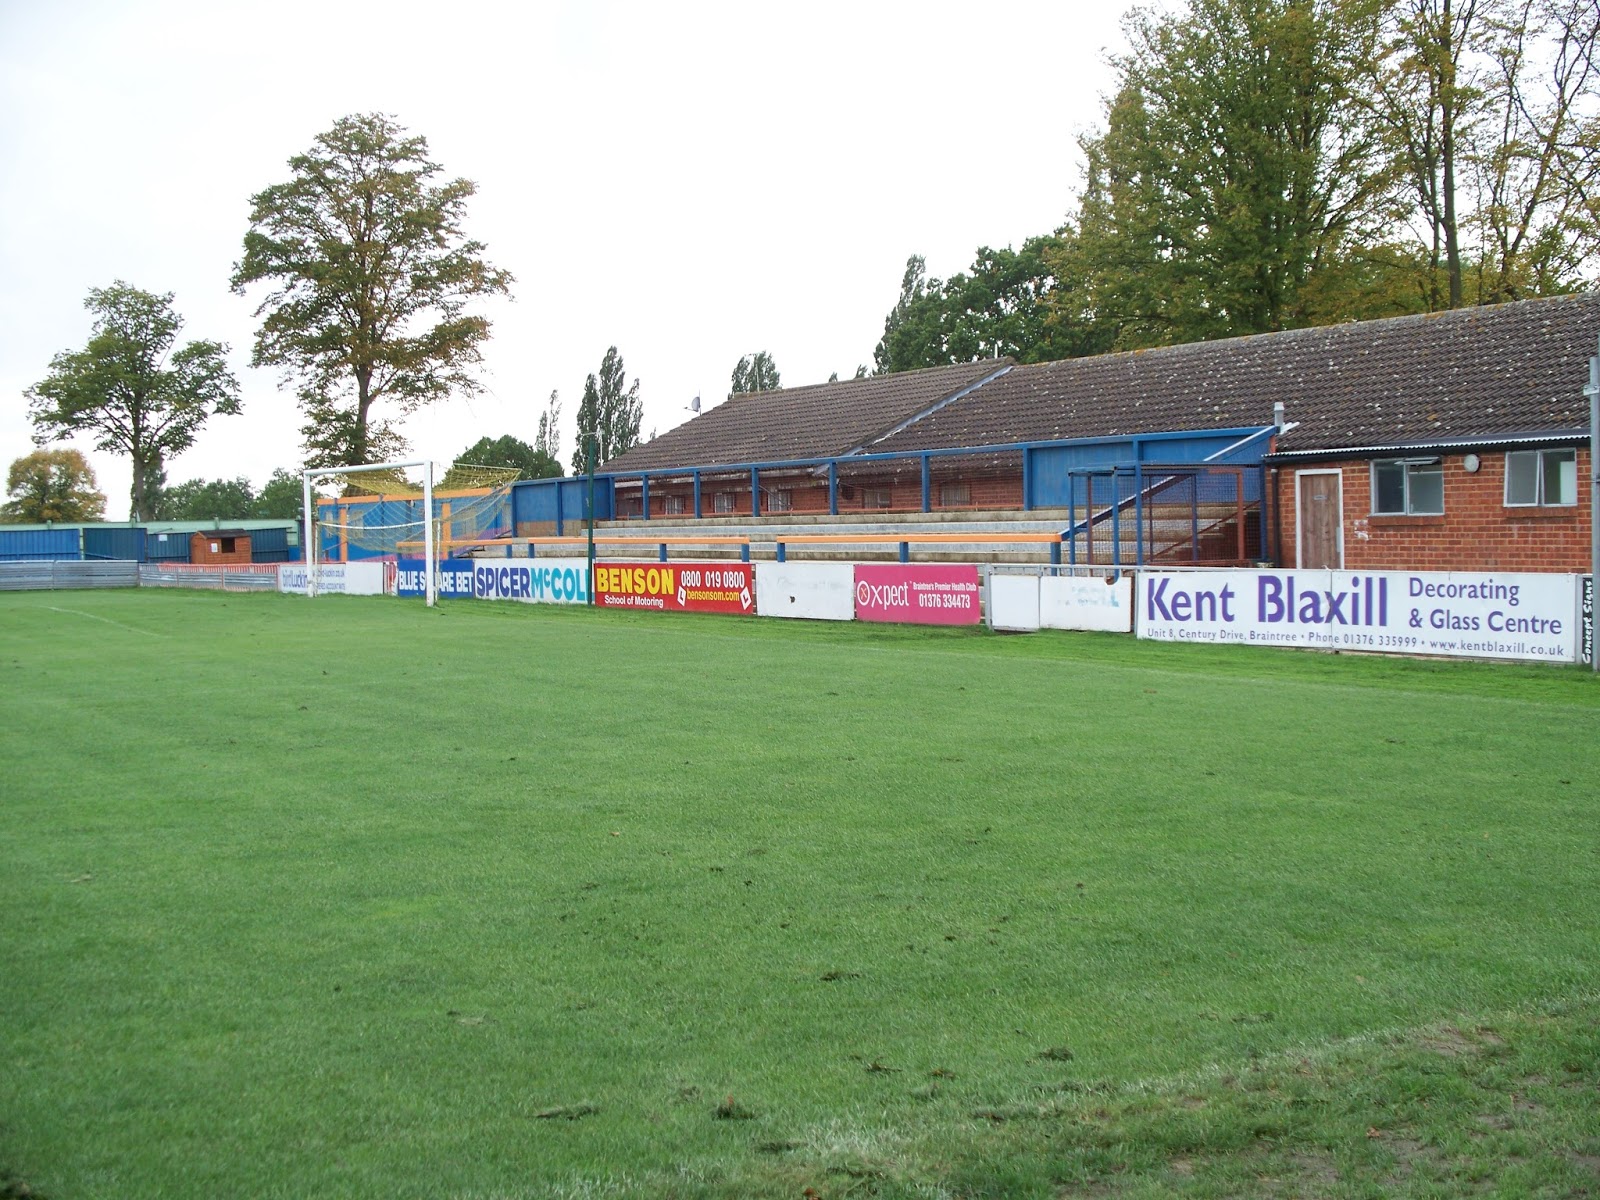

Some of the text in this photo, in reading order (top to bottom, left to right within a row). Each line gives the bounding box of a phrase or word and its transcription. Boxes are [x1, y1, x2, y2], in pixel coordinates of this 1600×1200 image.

[399, 570, 474, 593] BLUE SARE BET
[596, 568, 674, 595] BENSON
[680, 570, 745, 589] 0800 019 0800
[934, 582, 952, 591] Premier
[951, 583, 966, 591] Health
[965, 583, 977, 592] Club
[1409, 576, 1520, 607] Decorating
[604, 594, 664, 609] School of Motoring
[686, 587, 740, 602] bensonsom.com
[918, 593, 971, 609] 01376 334473
[1148, 577, 1235, 623] Kent
[1258, 575, 1387, 627] Blaxill
[1408, 607, 1562, 635] & Glass Centre
[1582, 580, 1594, 664] Concept Signs
[1147, 627, 1167, 638] Unit
[1178, 628, 1217, 641] Century
[1219, 629, 1247, 641] Drive,
[1249, 630, 1297, 642] Braintree
[1308, 631, 1340, 644] Phone
[1343, 633, 1374, 646] 01376
[1378, 635, 1417, 648] 335999
[1430, 639, 1564, 657] www.kentblaxill.co.uk
